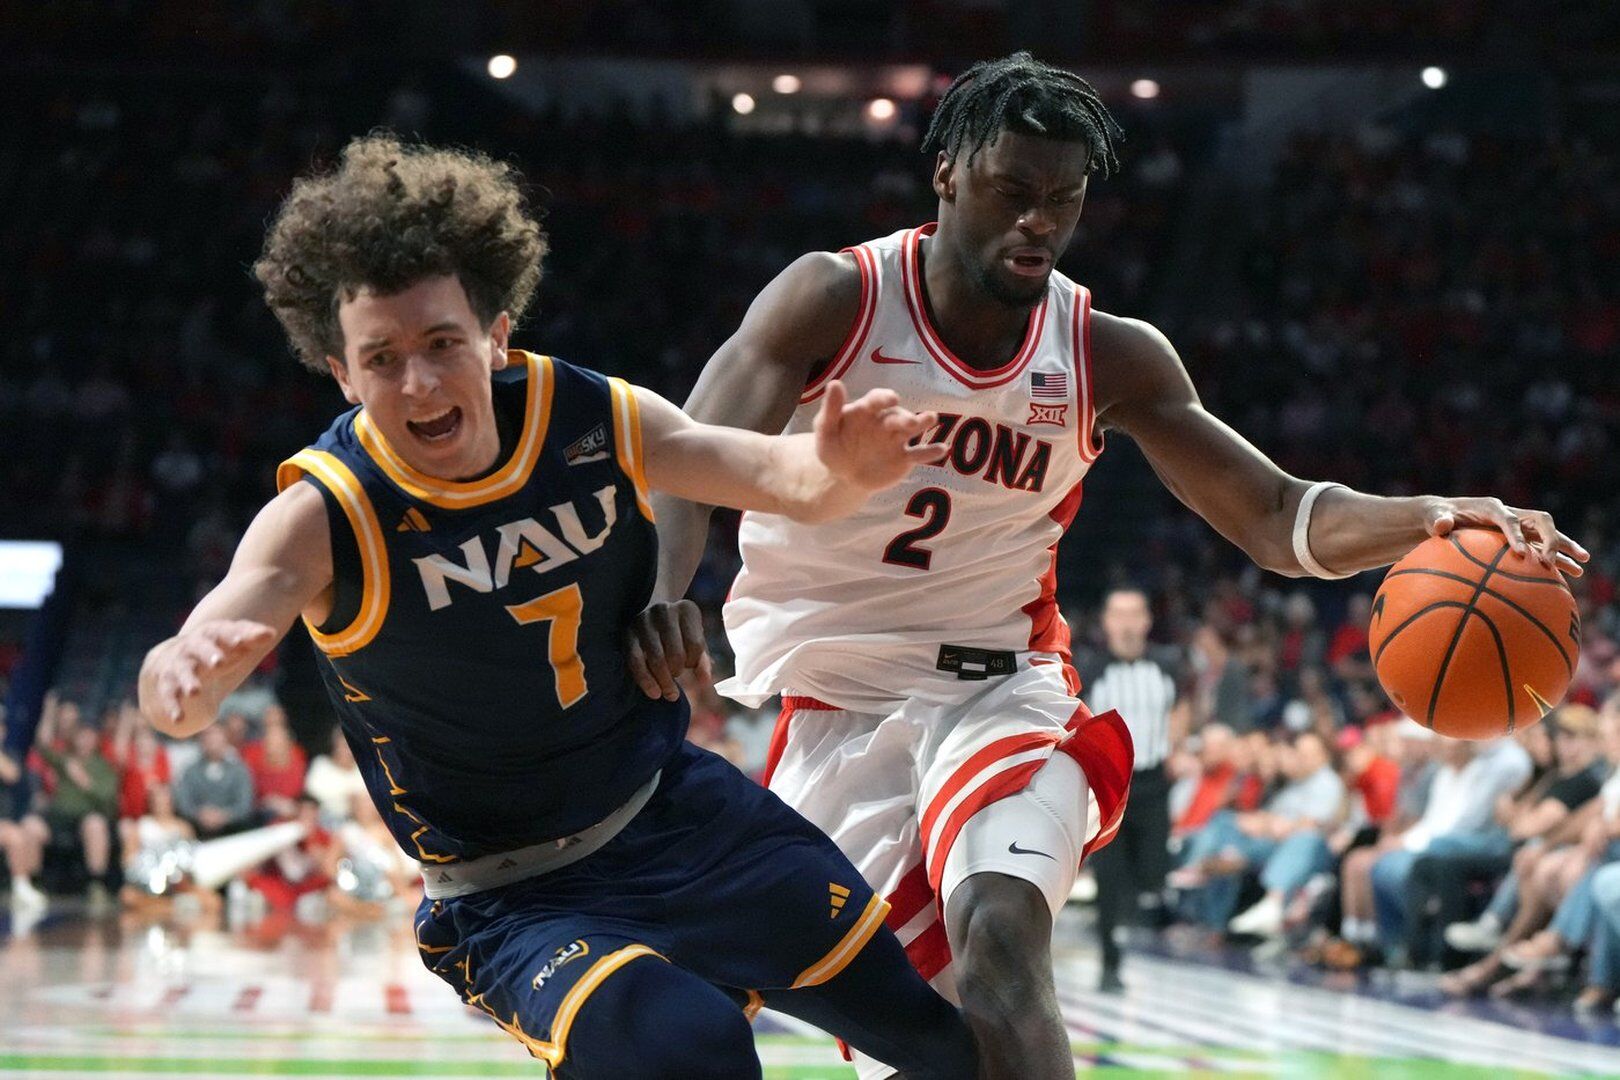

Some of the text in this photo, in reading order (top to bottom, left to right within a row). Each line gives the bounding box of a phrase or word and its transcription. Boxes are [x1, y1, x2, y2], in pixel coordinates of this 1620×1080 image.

[908, 411, 1053, 493] ZONA
[1028, 404, 1067, 426] XII
[410, 484, 618, 612] NAU
[882, 487, 952, 571] 2
[504, 582, 589, 710] 7
[533, 942, 581, 988] NAU
